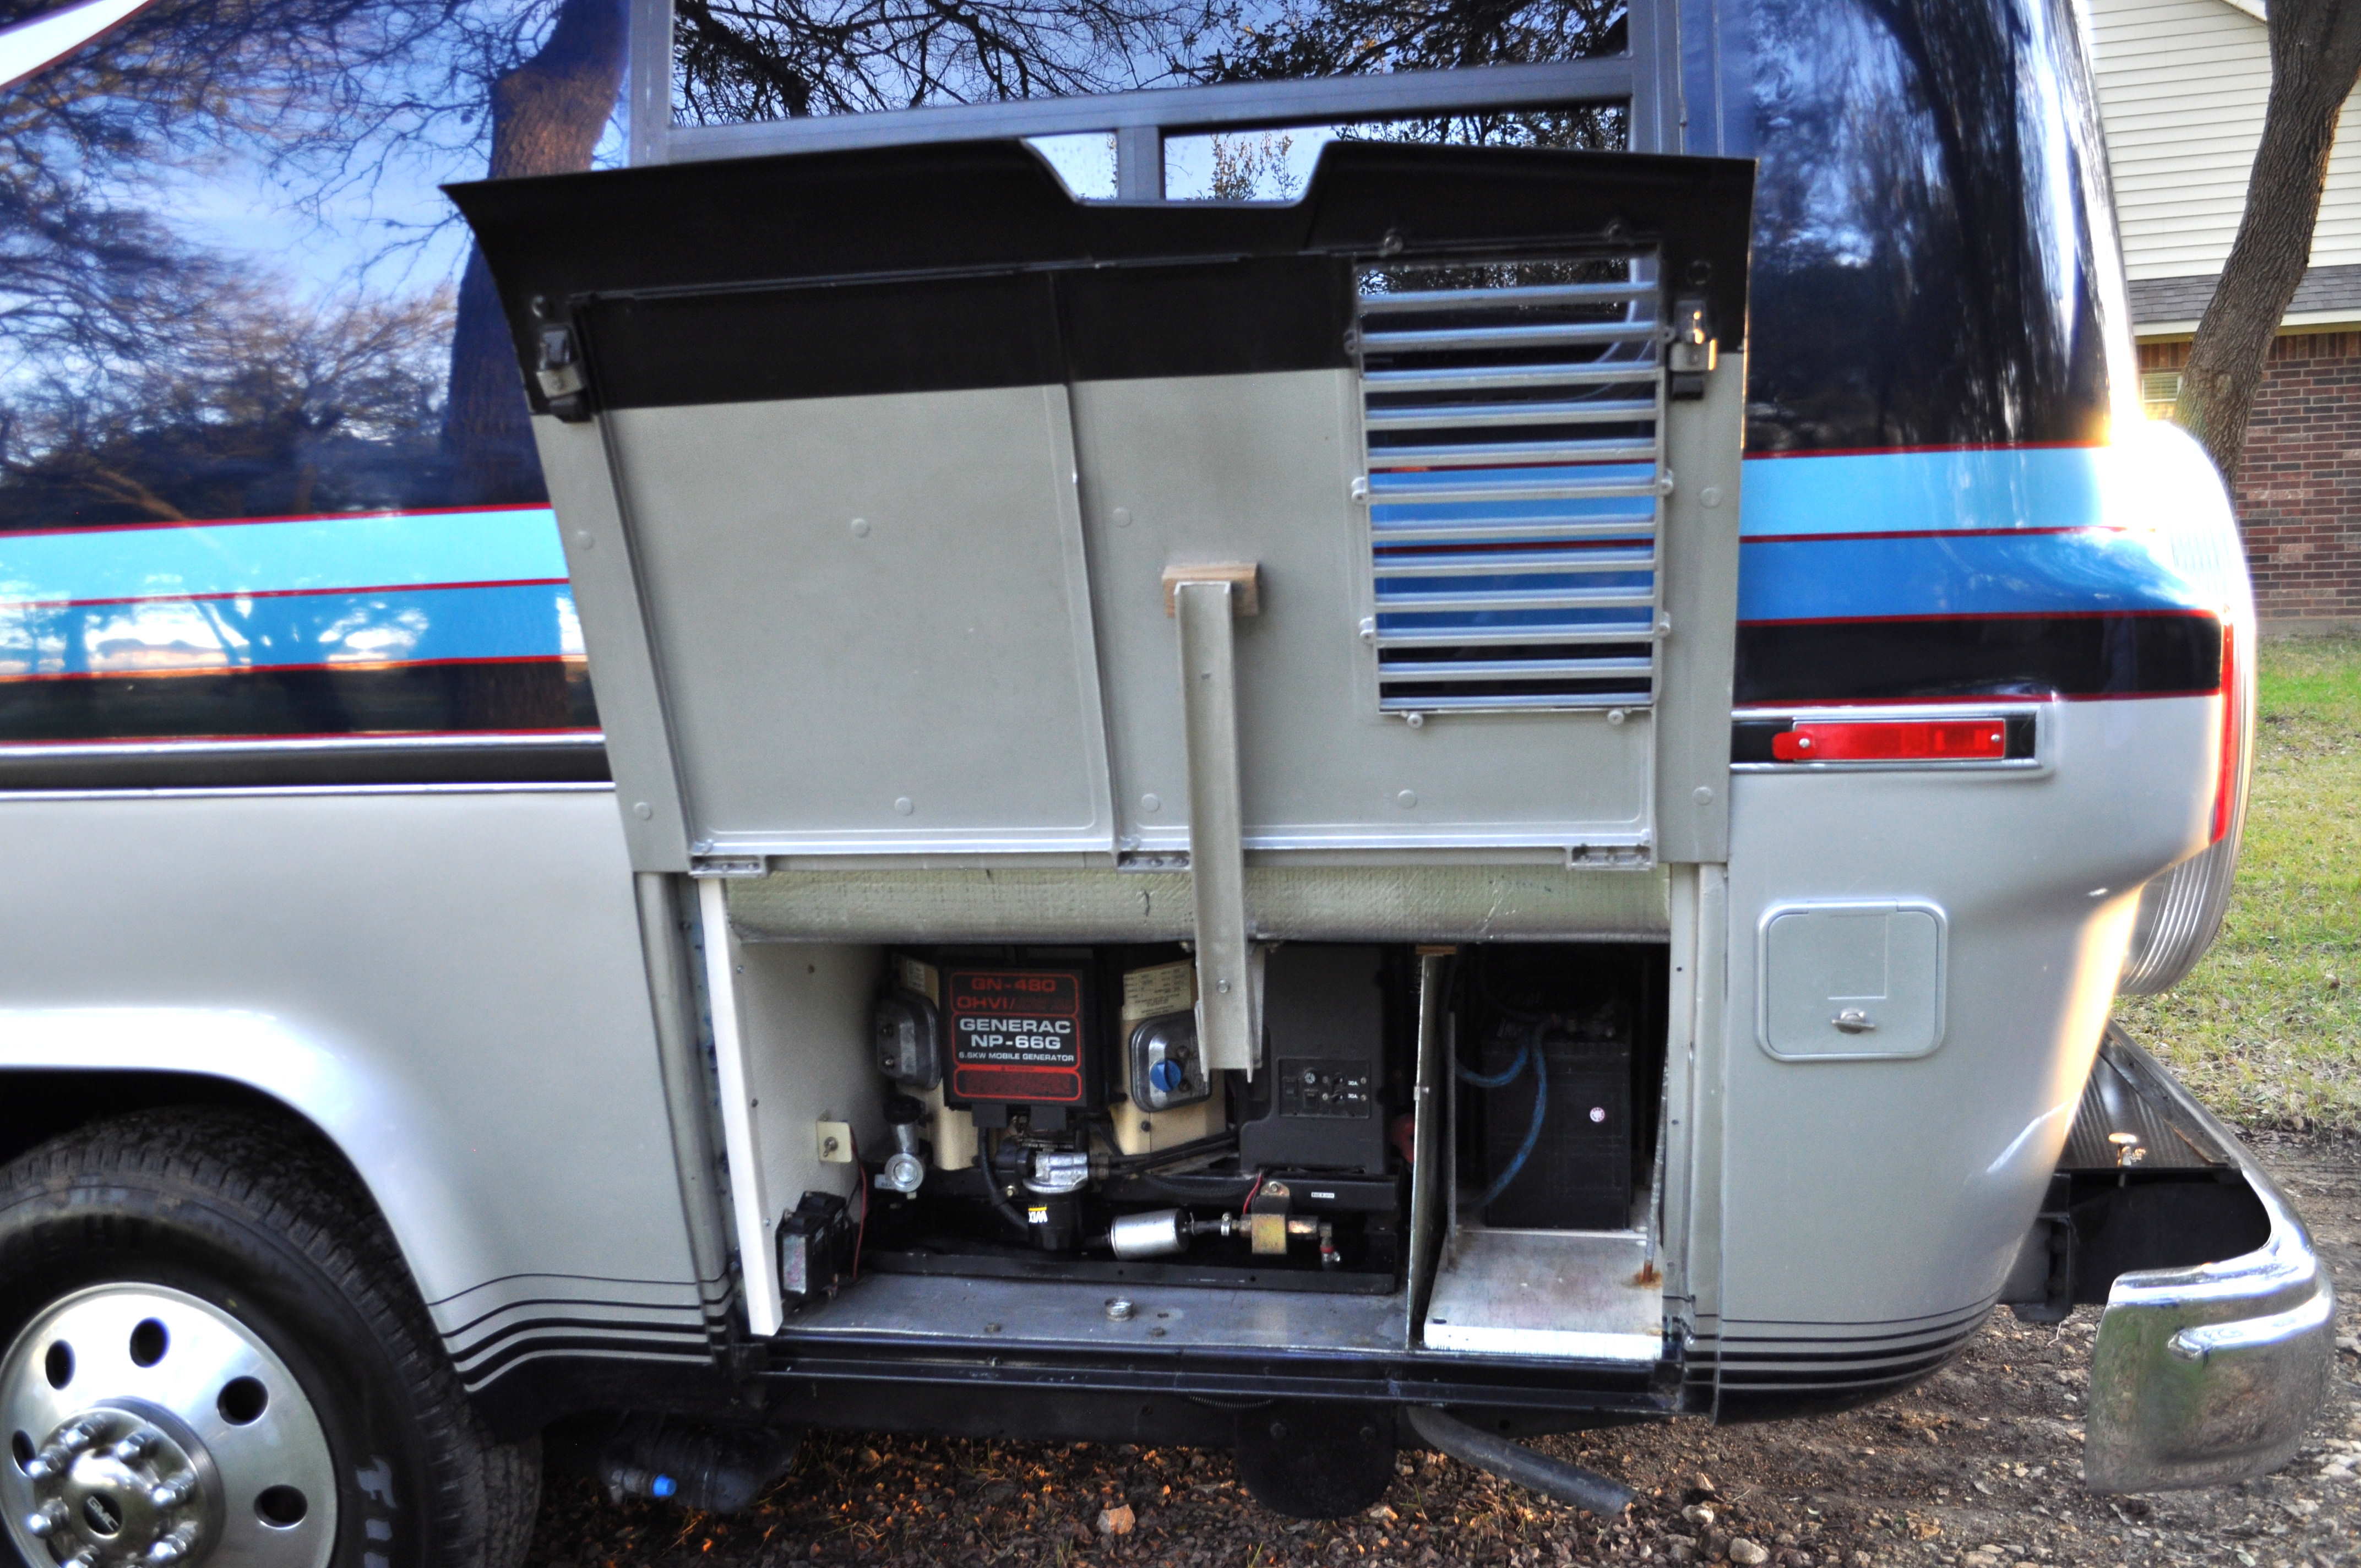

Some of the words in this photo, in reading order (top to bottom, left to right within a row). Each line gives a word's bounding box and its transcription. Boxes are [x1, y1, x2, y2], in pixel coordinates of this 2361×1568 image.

[972, 978, 1056, 992] GN-480
[960, 1018, 1071, 1033] GENERAC
[971, 1035, 1060, 1049] NP-66G
[87, 1496, 118, 1531] GMC
